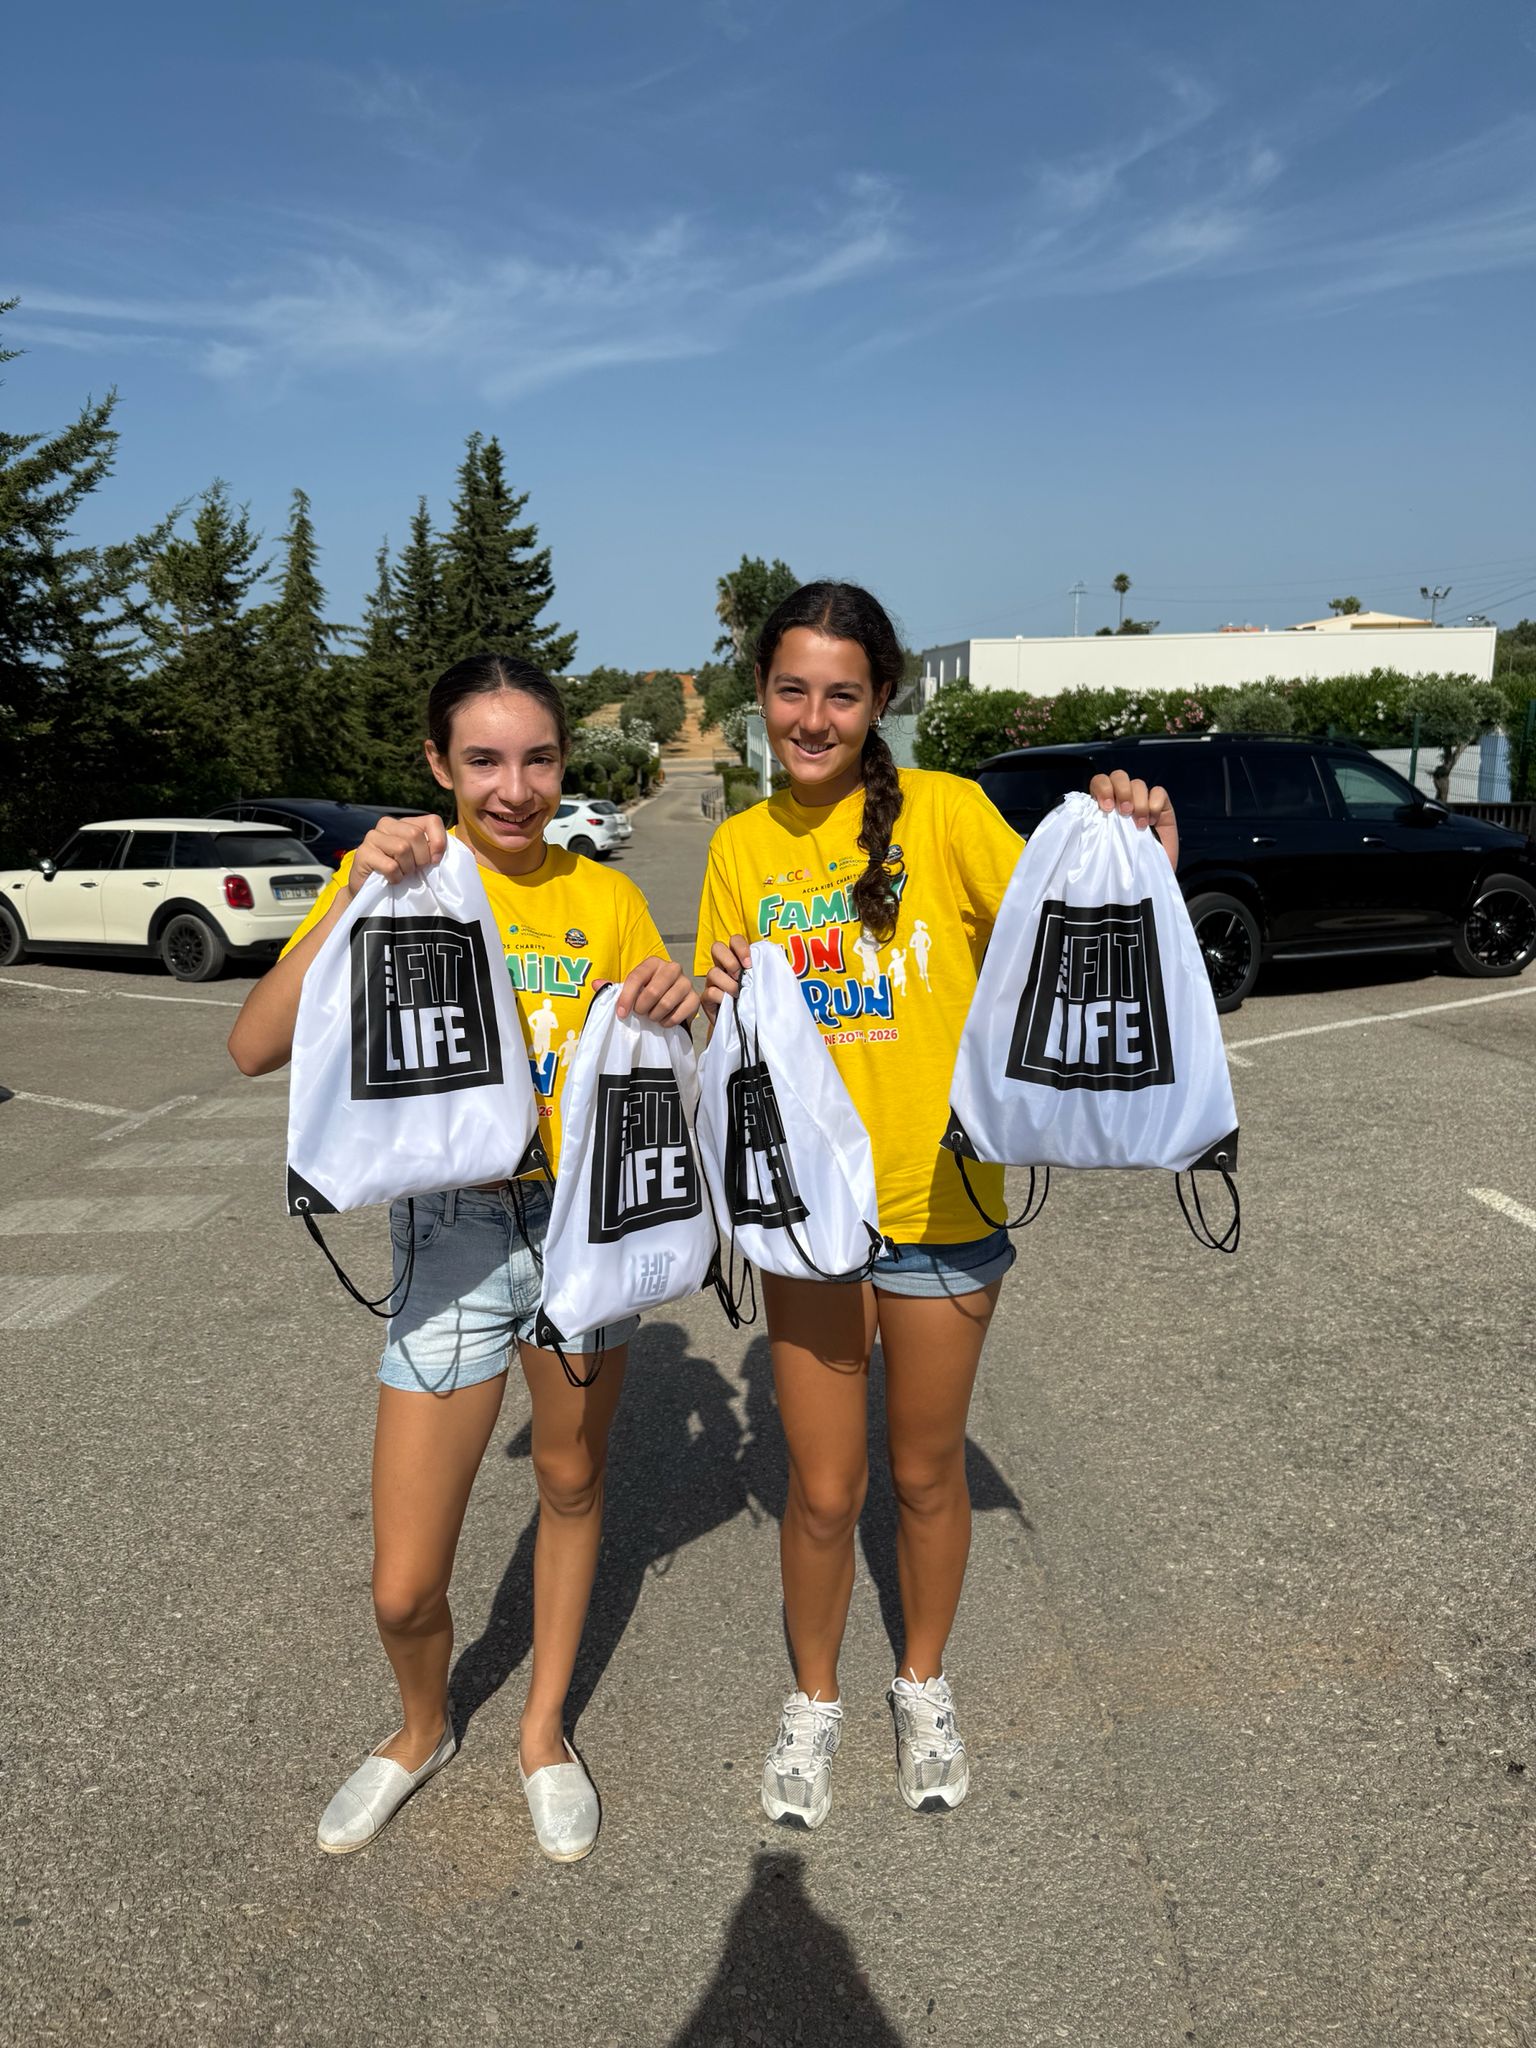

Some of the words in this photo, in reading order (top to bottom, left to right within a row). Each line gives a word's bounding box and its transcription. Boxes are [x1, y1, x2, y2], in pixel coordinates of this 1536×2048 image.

[776, 867, 813, 883] ACCA
[802, 886, 819, 894] ACCA
[820, 882, 834, 890] KIDS
[394, 943, 463, 1007] FIT
[785, 927, 846, 979] UN
[1068, 933, 1139, 1001] FIT
[800, 973, 895, 1028] RUN
[386, 1006, 471, 1071] LIFE
[869, 1029, 898, 1041] 2026
[1044, 996, 1143, 1065] LIFE
